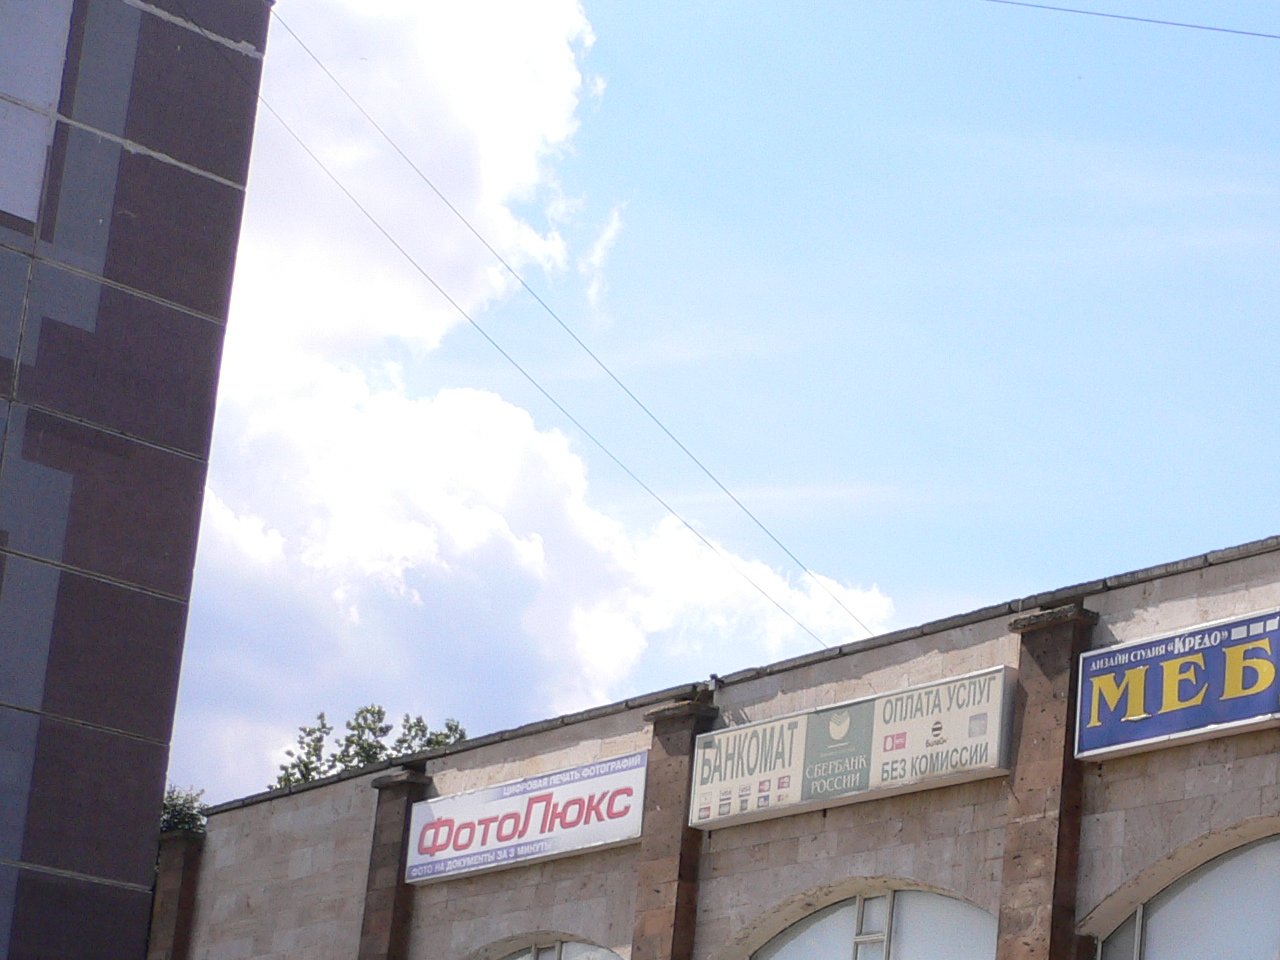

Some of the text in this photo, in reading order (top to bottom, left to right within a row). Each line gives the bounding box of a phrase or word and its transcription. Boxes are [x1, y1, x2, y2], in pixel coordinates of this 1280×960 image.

[882, 675, 997, 725] ОПЛАТА УСЛУГ
[700, 721, 799, 785] БАНКОМАТ
[805, 754, 868, 779] СБЕРБАНК
[881, 758, 907, 782] БЕЗ
[910, 742, 989, 777] КОМИССИИ
[549, 770, 581, 787] ПЕЧАТЬ
[811, 773, 860, 794] РОССИИ
[411, 866, 432, 876] ФОТО
[434, 863, 445, 872] НА
[497, 849, 507, 860] ЗА
